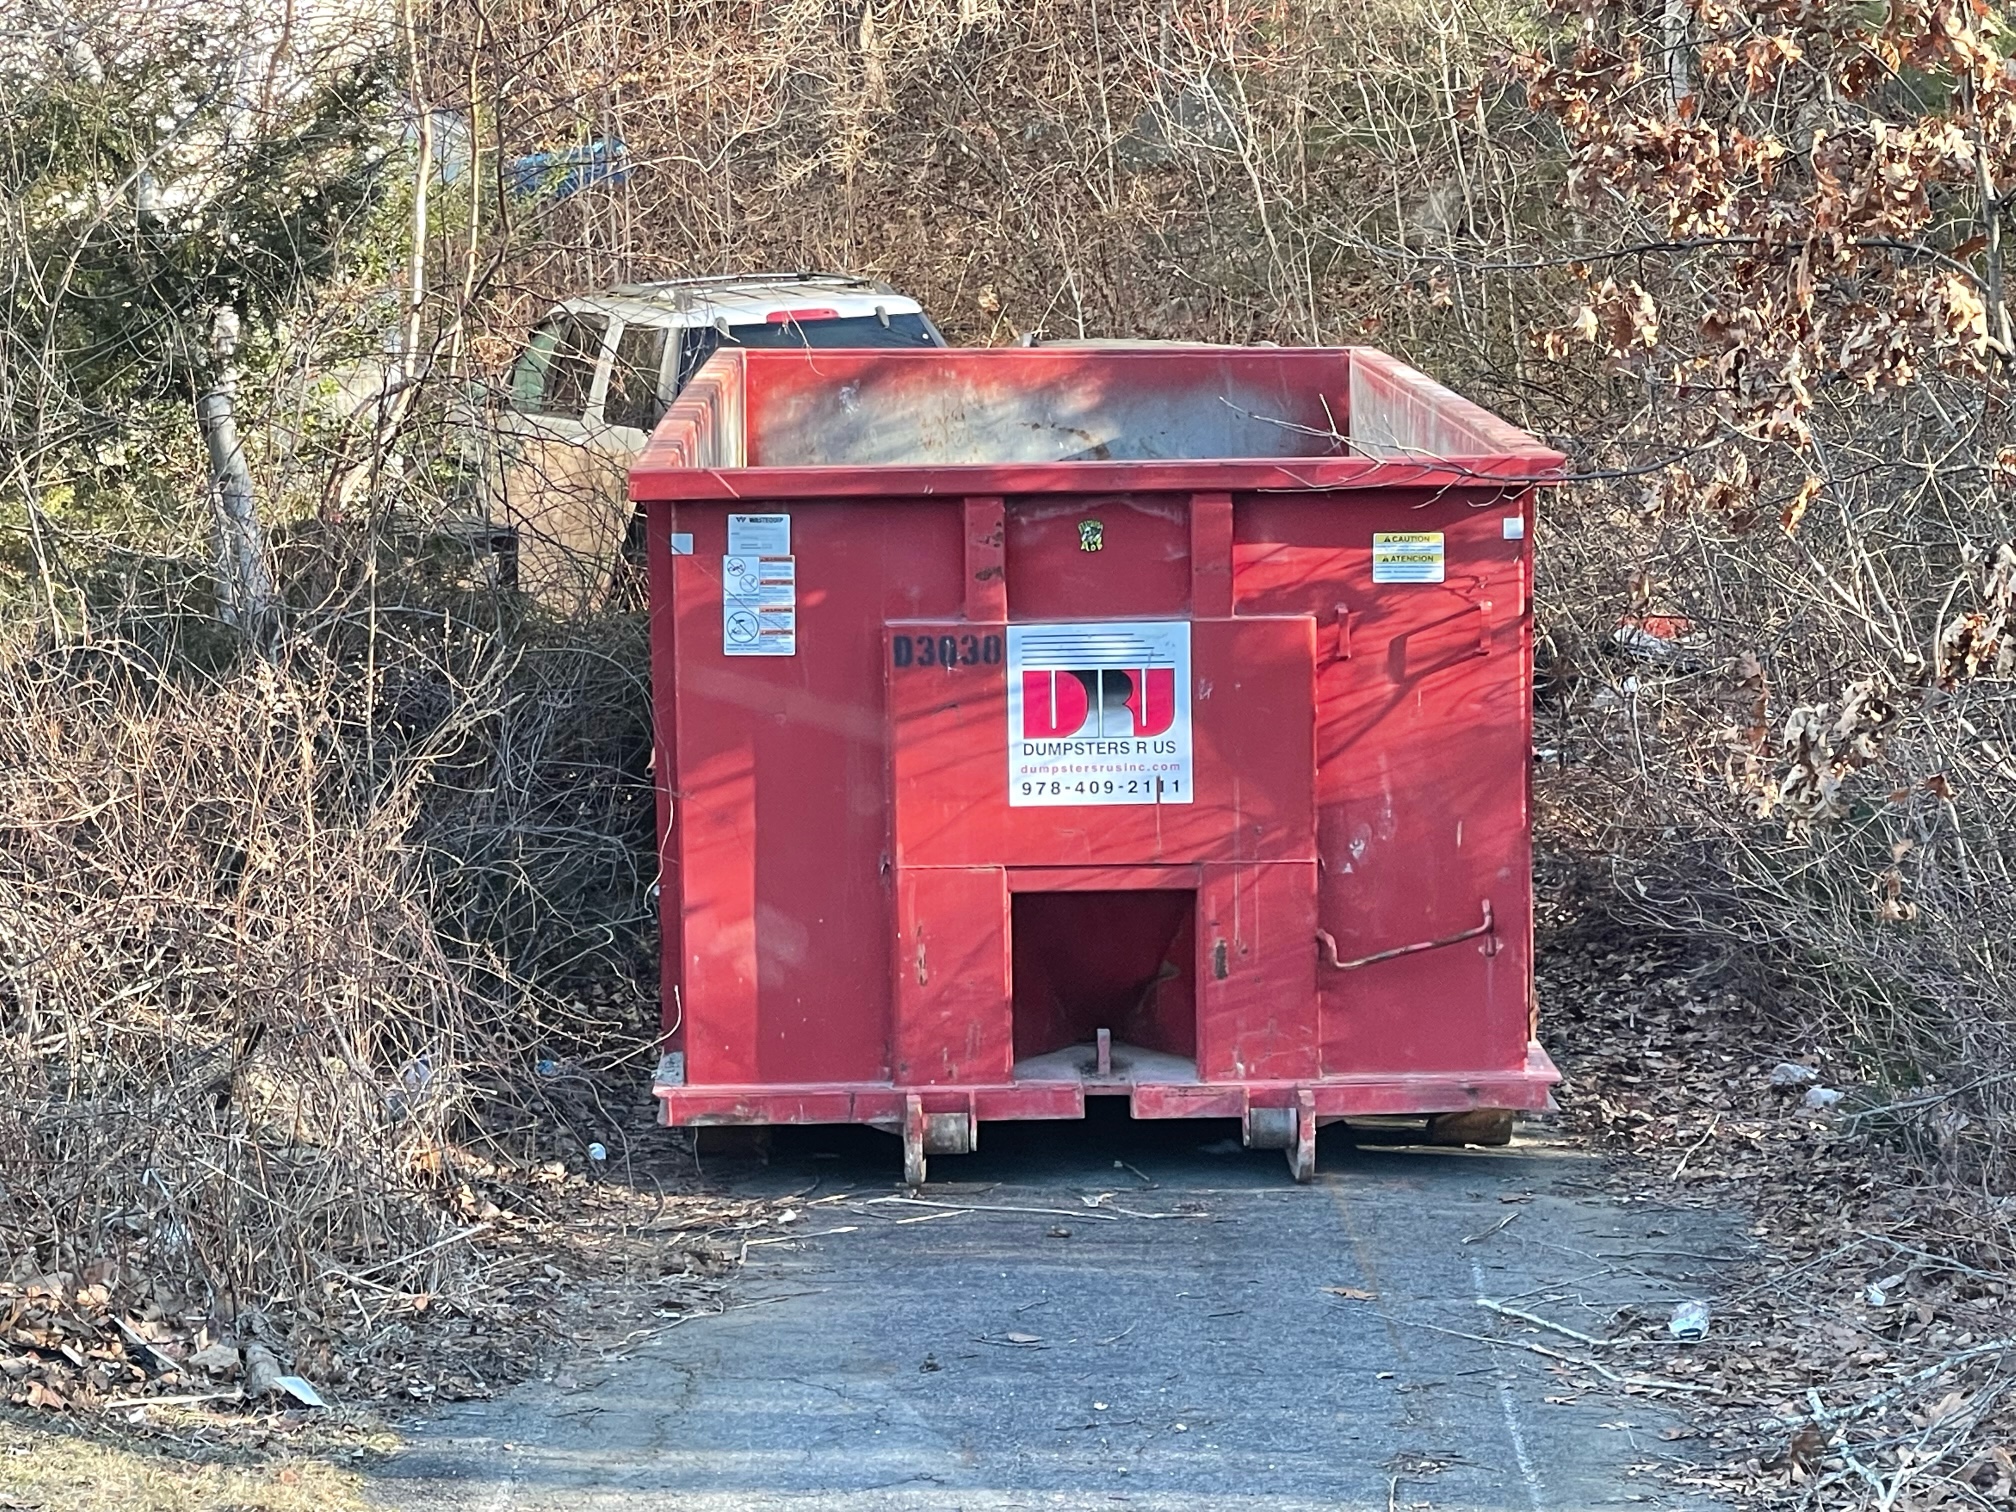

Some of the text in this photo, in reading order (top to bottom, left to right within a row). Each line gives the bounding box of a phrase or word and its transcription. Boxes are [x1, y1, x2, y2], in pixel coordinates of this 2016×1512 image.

[1392, 535, 1430, 543] CAUTION
[1390, 555, 1434, 563] ATENCION
[1022, 668, 1175, 739] DRU
[1023, 740, 1176, 756] DUMPSTERS R US
[1021, 779, 1180, 796] 978-409-2111
